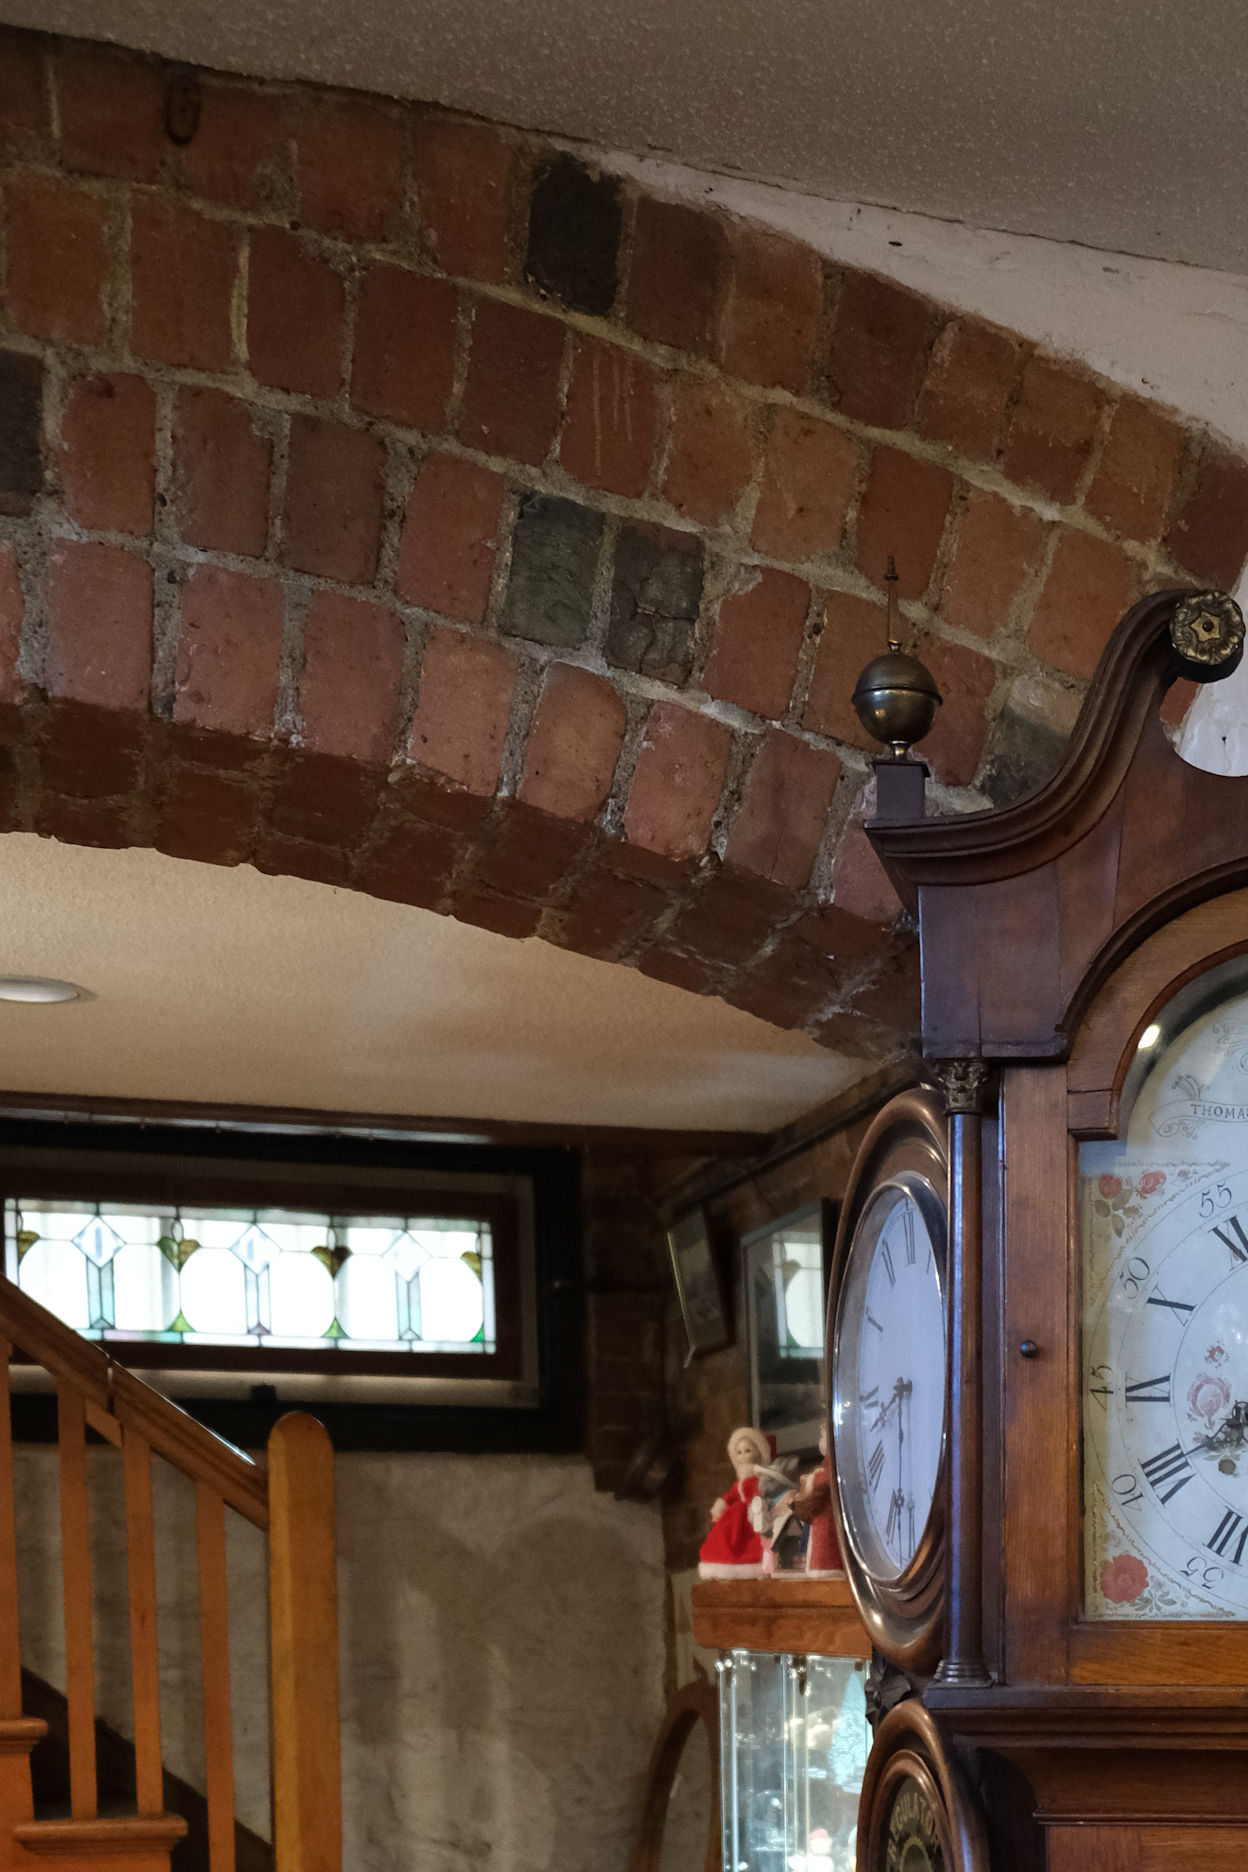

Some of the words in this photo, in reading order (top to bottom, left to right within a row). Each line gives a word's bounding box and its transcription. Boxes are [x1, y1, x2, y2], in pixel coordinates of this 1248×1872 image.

[1199, 1183, 1232, 1217] 55
[1119, 1257, 1150, 1299] 50
[1090, 1365, 1114, 1411] 45
[1111, 1473, 1144, 1512] 40
[1179, 1556, 1224, 1589] 35
